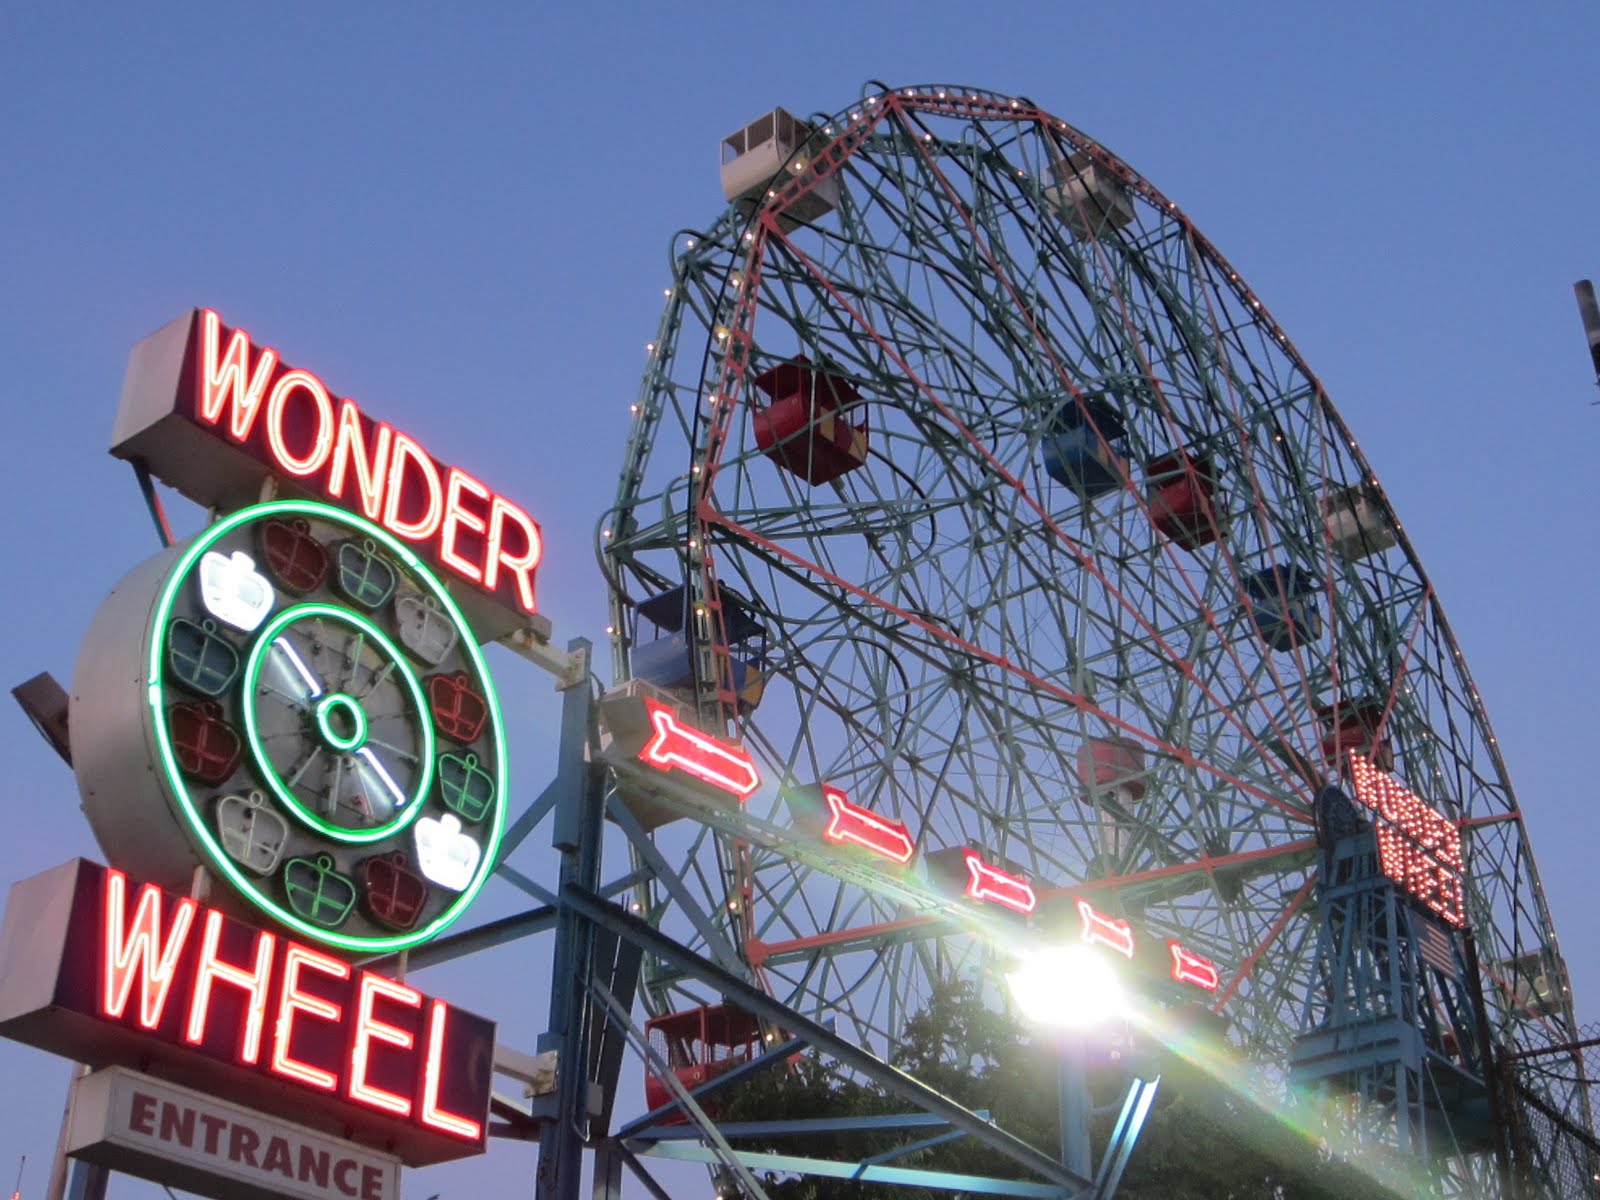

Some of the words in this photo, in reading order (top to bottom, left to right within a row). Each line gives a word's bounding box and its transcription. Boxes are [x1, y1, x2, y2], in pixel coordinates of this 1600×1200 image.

[196, 307, 543, 614] WONDER
[99, 867, 482, 1141] WHEEL
[128, 1091, 384, 1200] ENTRANCE
